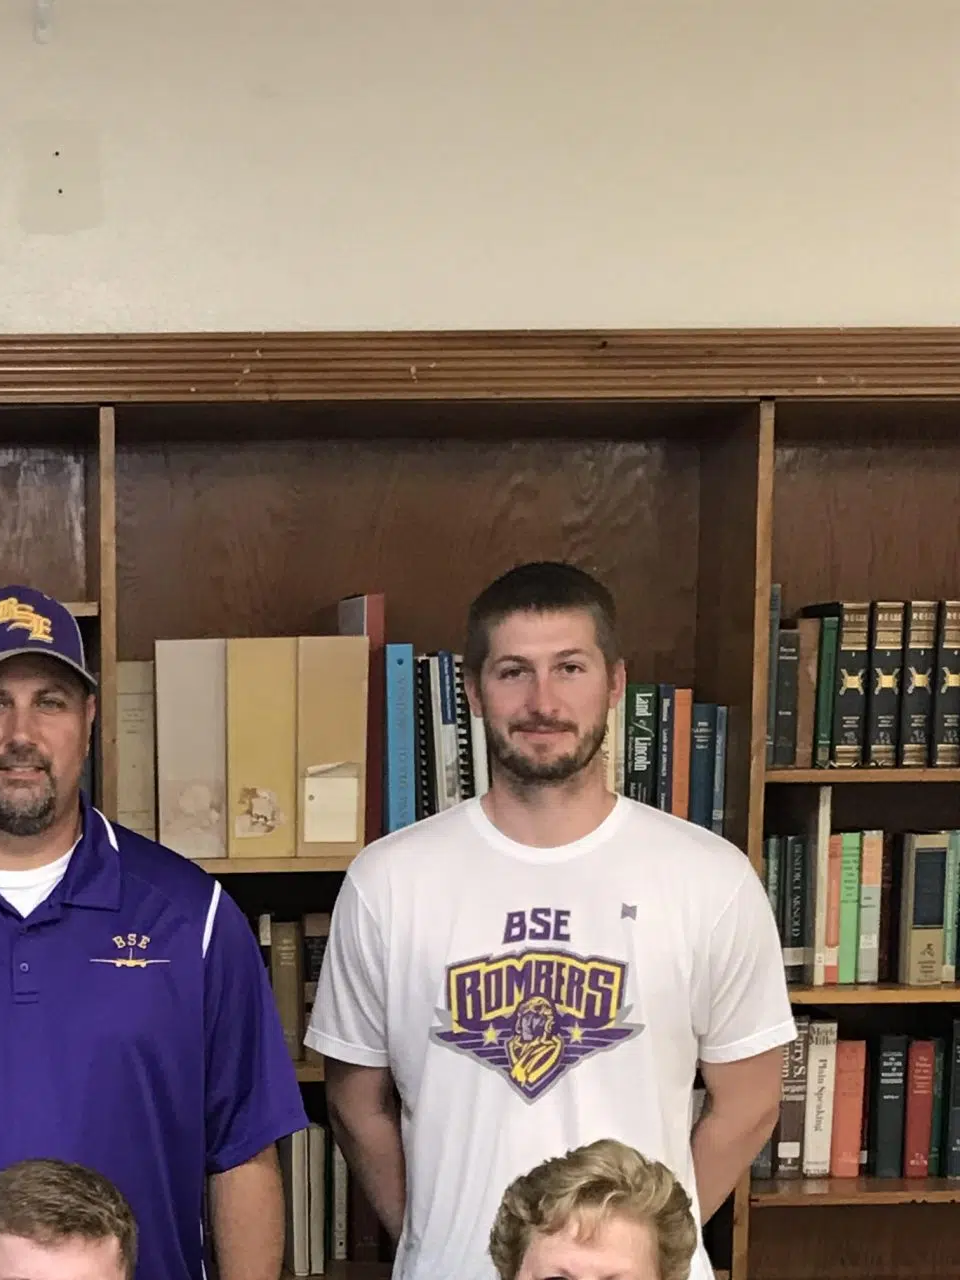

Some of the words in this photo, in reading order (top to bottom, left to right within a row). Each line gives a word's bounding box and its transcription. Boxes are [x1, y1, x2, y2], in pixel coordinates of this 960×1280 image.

[635, 692, 653, 717] Land
[631, 718, 655, 738] of
[633, 736, 652, 771] Lincoln
[502, 907, 571, 945] BSE
[792, 894, 802, 937] ARNOLD
[112, 933, 151, 949] BSE
[454, 955, 617, 1032] BOMBERS
[816, 1058, 828, 1083] Plain
[814, 1085, 827, 1132] Speaking
